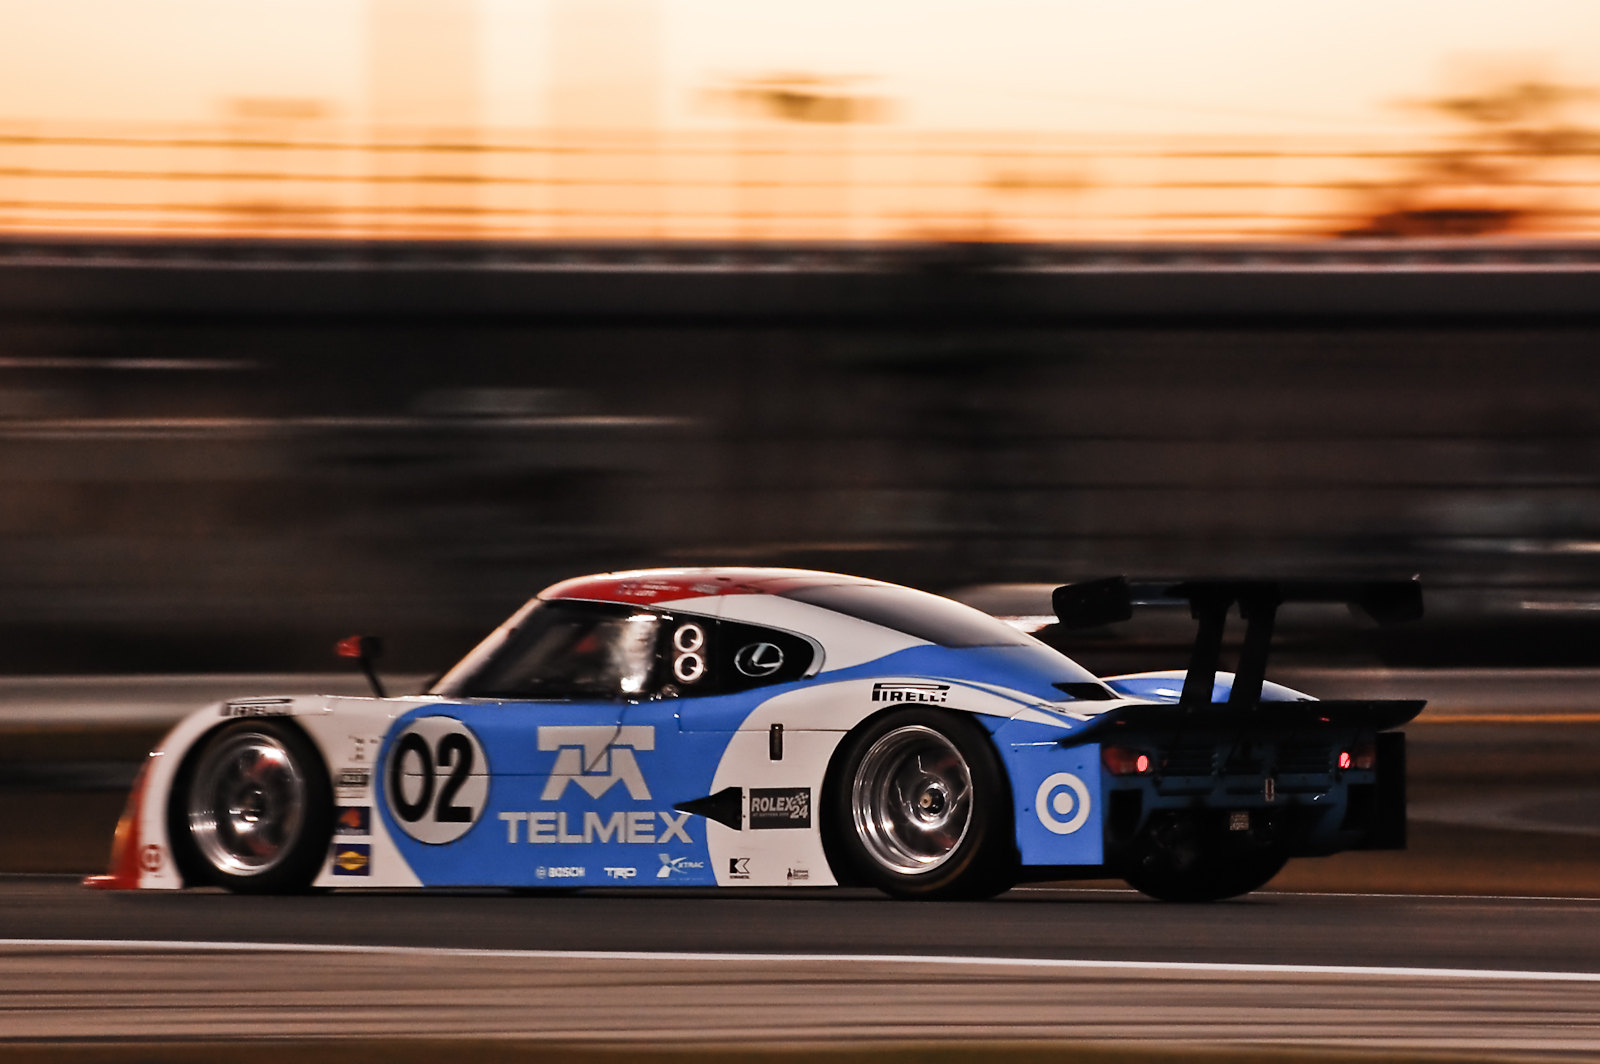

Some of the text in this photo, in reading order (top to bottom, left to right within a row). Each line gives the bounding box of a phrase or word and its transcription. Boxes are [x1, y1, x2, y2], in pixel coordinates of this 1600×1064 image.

[872, 683, 950, 702] PIRELLI
[391, 732, 474, 823] 02
[751, 797, 794, 812] ROLEX
[790, 805, 809, 819] 24
[498, 812, 693, 844] TELMEX
[548, 867, 586, 878] BOSCH
[604, 867, 637, 879] TRD
